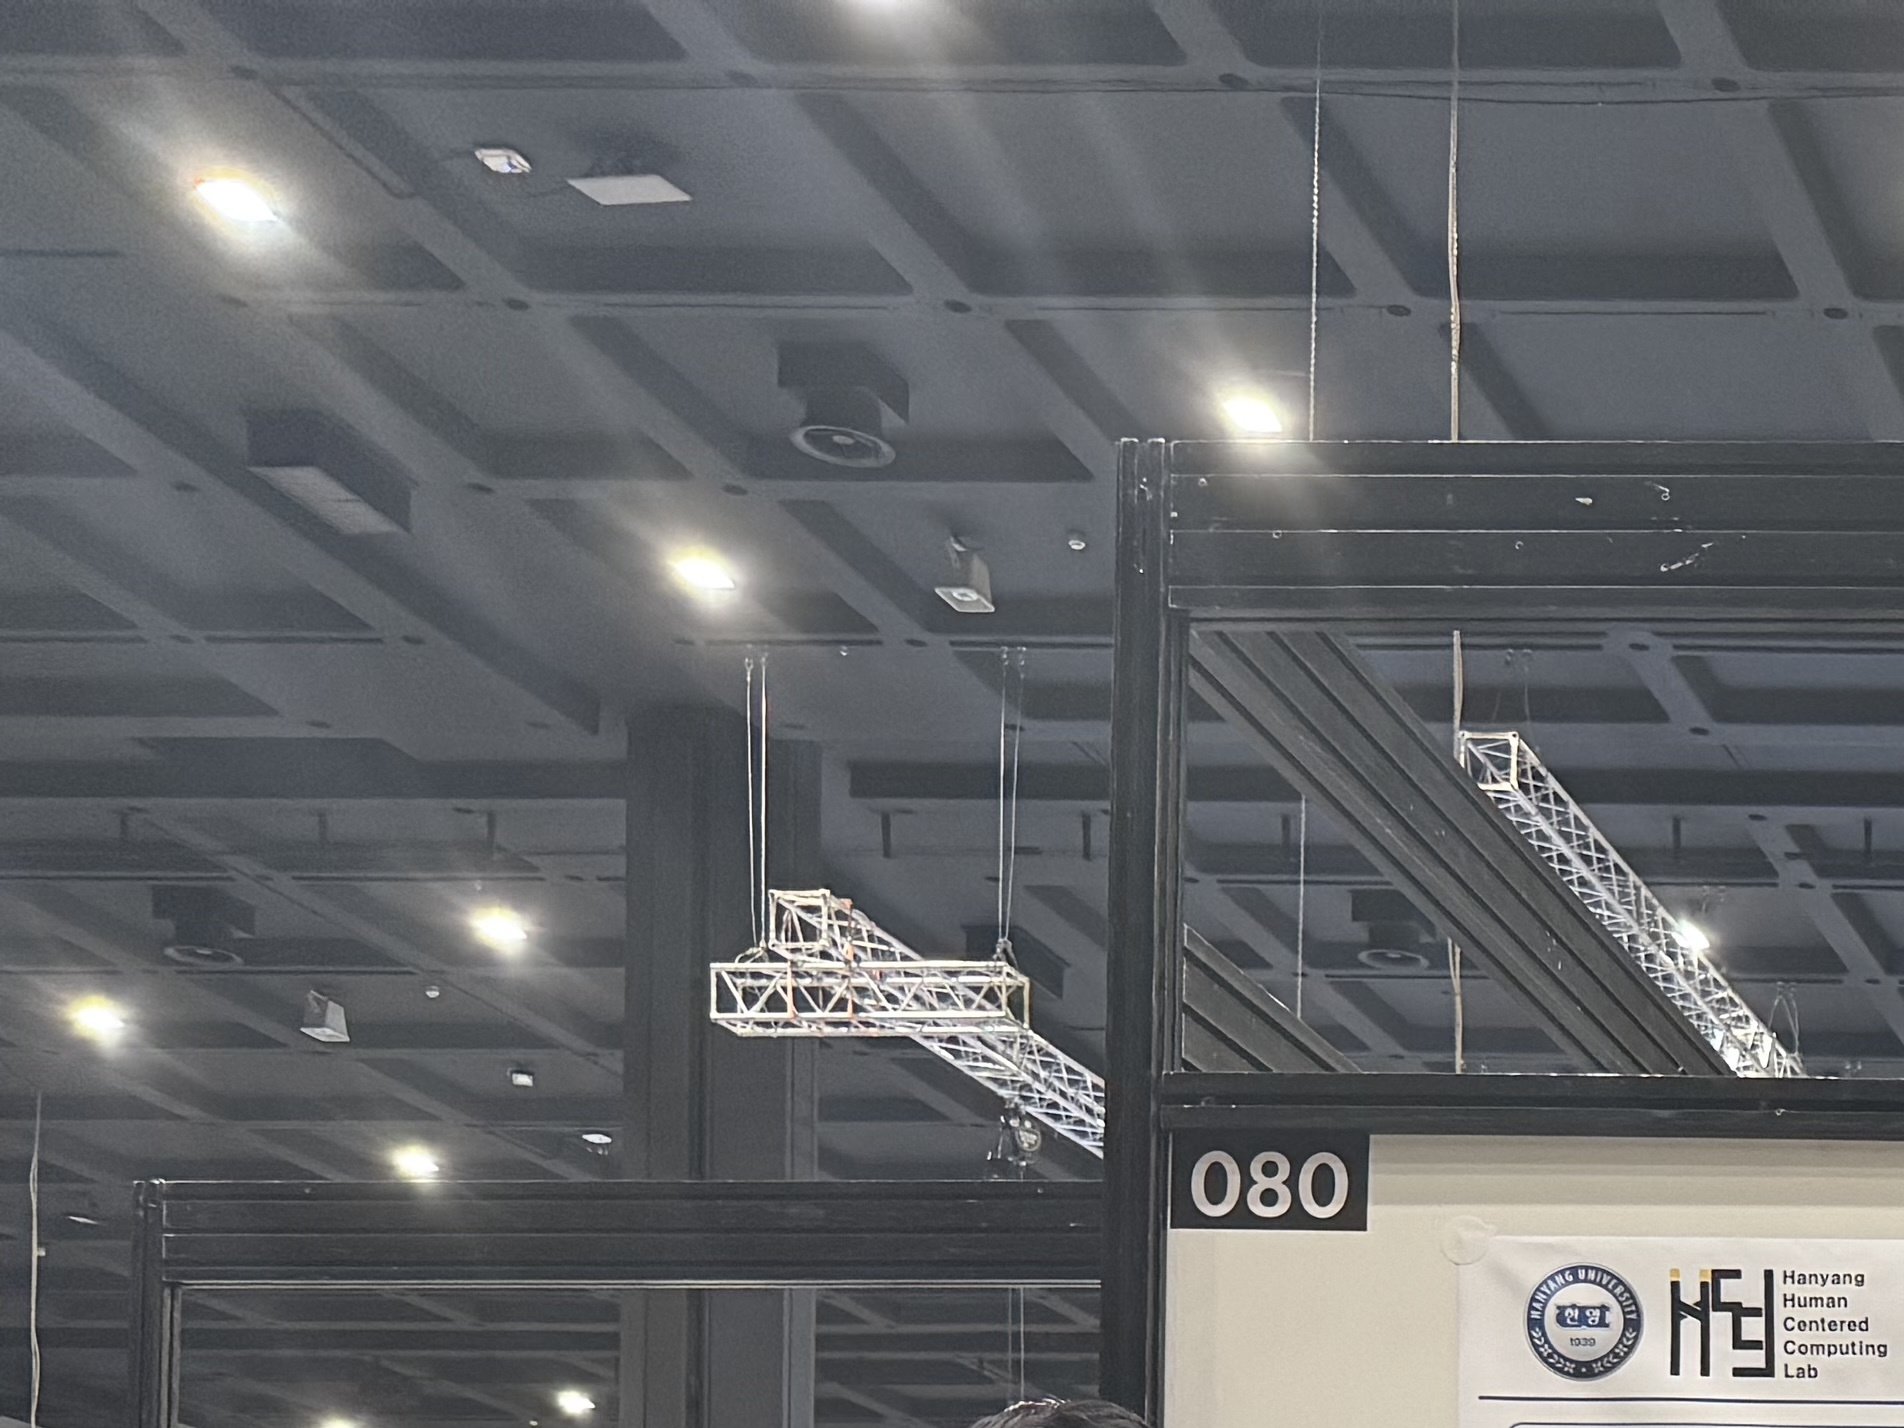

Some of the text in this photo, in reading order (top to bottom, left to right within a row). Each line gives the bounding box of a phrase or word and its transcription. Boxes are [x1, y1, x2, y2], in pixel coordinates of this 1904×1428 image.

[1191, 1151, 1348, 1219] 080
[1783, 1270, 1865, 1287] Hanyang
[1530, 1268, 1639, 1320] HANYANG UNIVERSITY
[1783, 1293, 1848, 1308] Human
[1783, 1316, 1869, 1332] Centered
[1783, 1340, 1887, 1358] Computing
[1784, 1363, 1818, 1379] Lab
